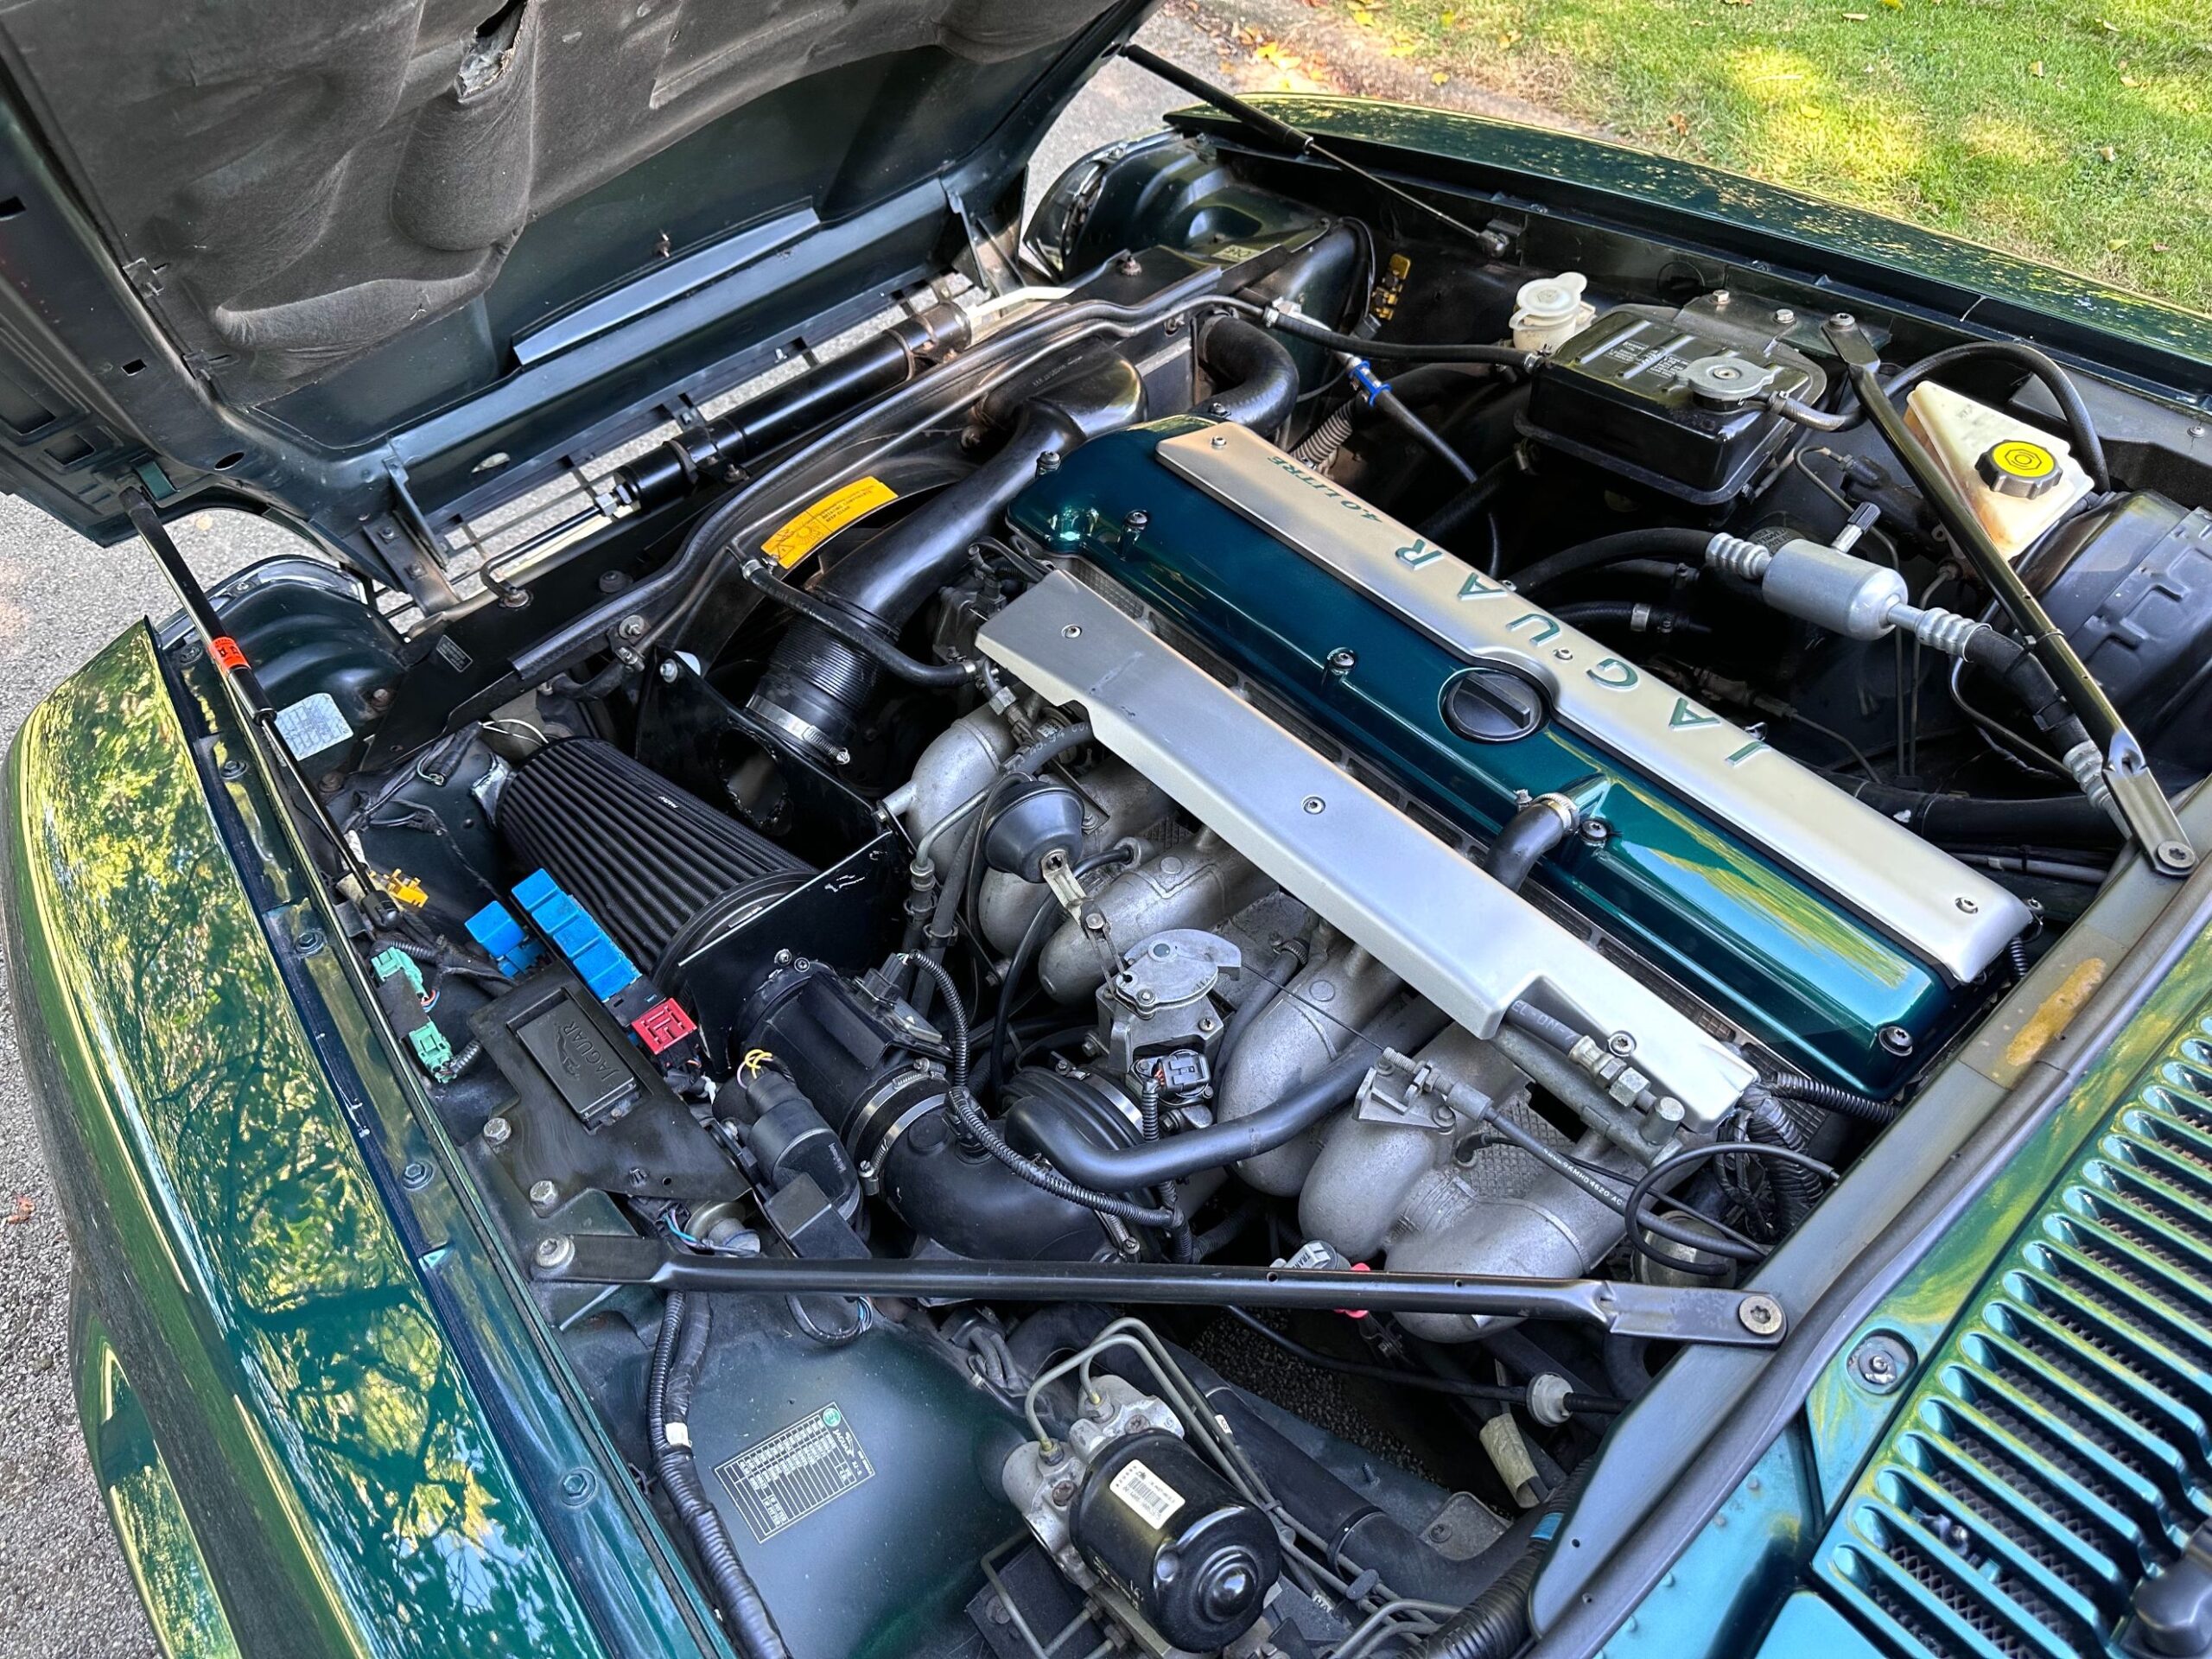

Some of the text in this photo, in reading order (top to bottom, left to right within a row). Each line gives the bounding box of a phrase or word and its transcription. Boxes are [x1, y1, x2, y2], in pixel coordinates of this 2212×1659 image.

[1267, 455, 1382, 524] 4.0 LITRE
[1395, 537, 1771, 767] JAGUAR
[563, 1020, 620, 1080] JAGUAR
[831, 1428, 851, 1456] JAGUAR
